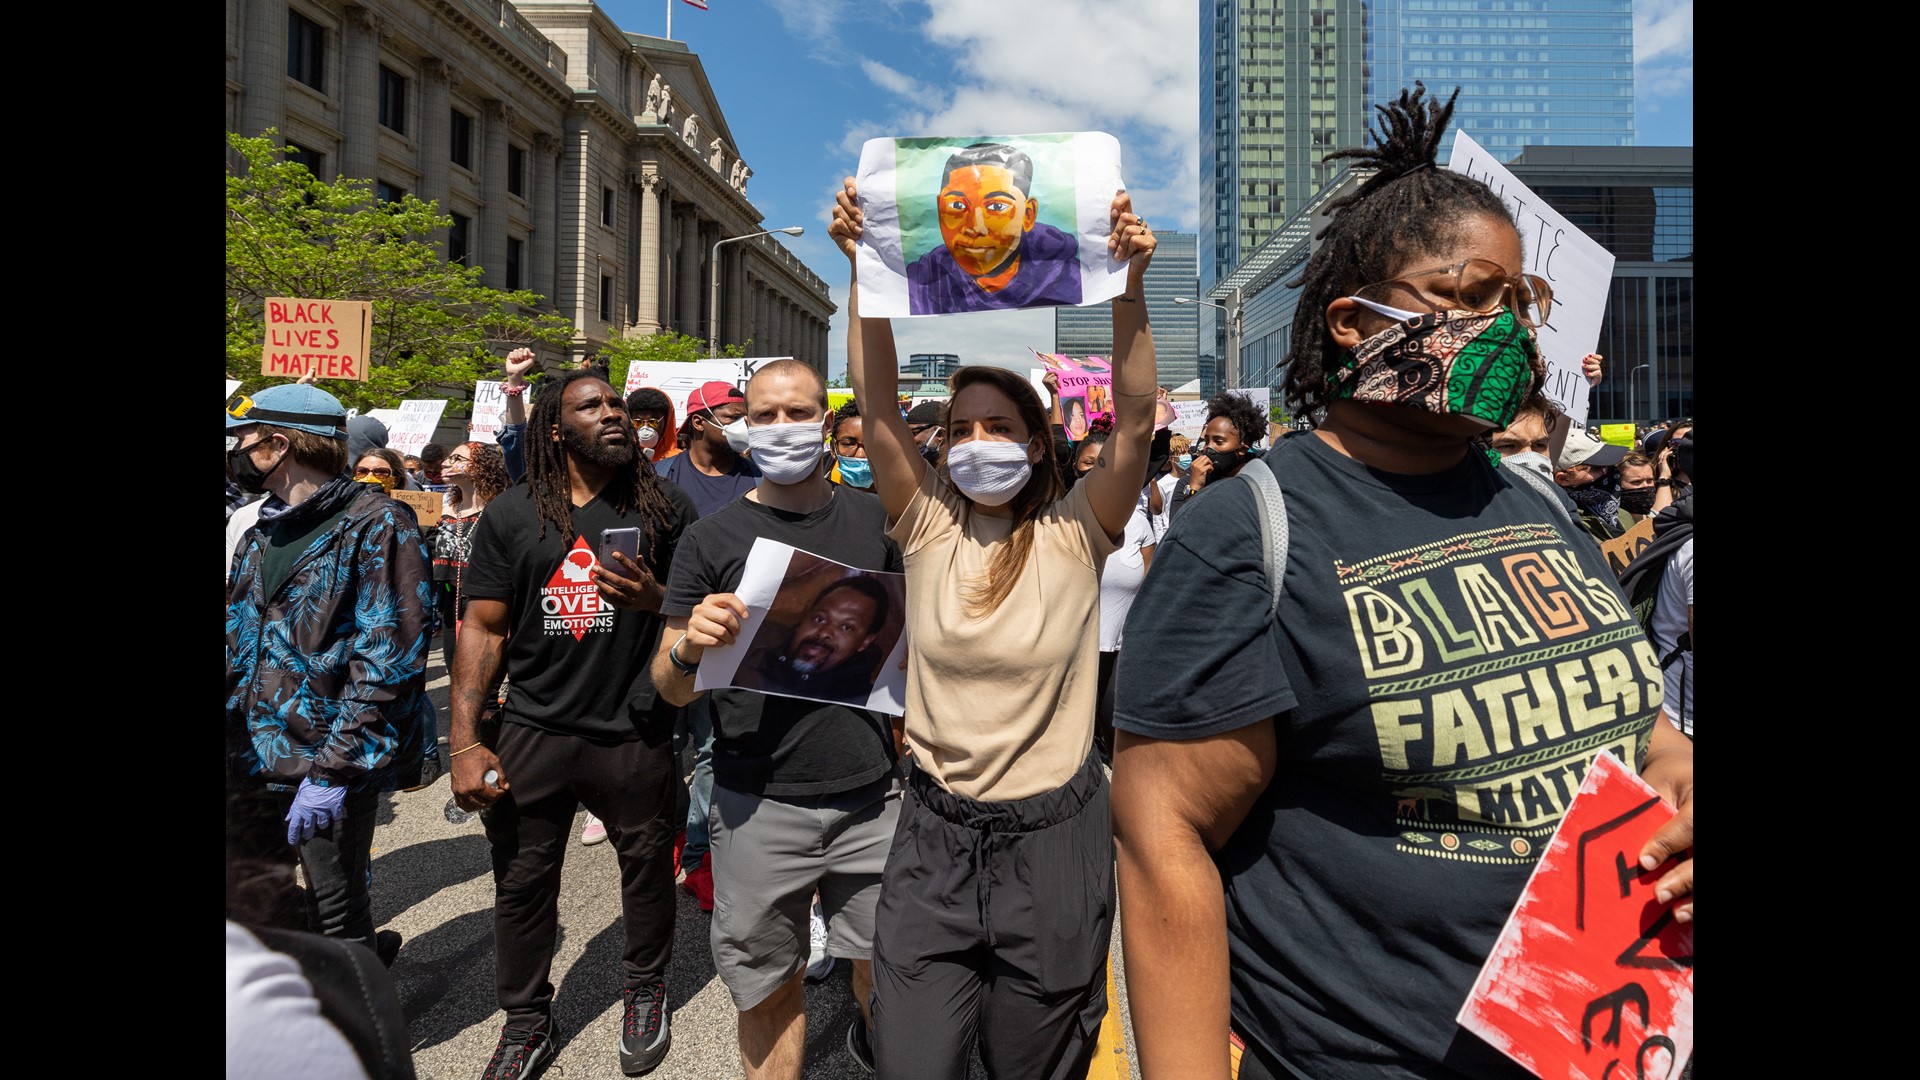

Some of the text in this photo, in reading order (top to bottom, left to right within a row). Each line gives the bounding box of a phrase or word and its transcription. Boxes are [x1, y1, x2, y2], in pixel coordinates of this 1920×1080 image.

[269, 302, 334, 324] BLACK
[272, 329, 339, 350] LIVES
[270, 353, 356, 377] MATTER
[1062, 376, 1089, 387] STOP
[541, 594, 615, 614] OVER
[1343, 549, 1632, 679] BLACK
[544, 617, 613, 630] EMOTIONS
[1370, 640, 1664, 770] FATHERS
[1477, 744, 1627, 824] MATT
